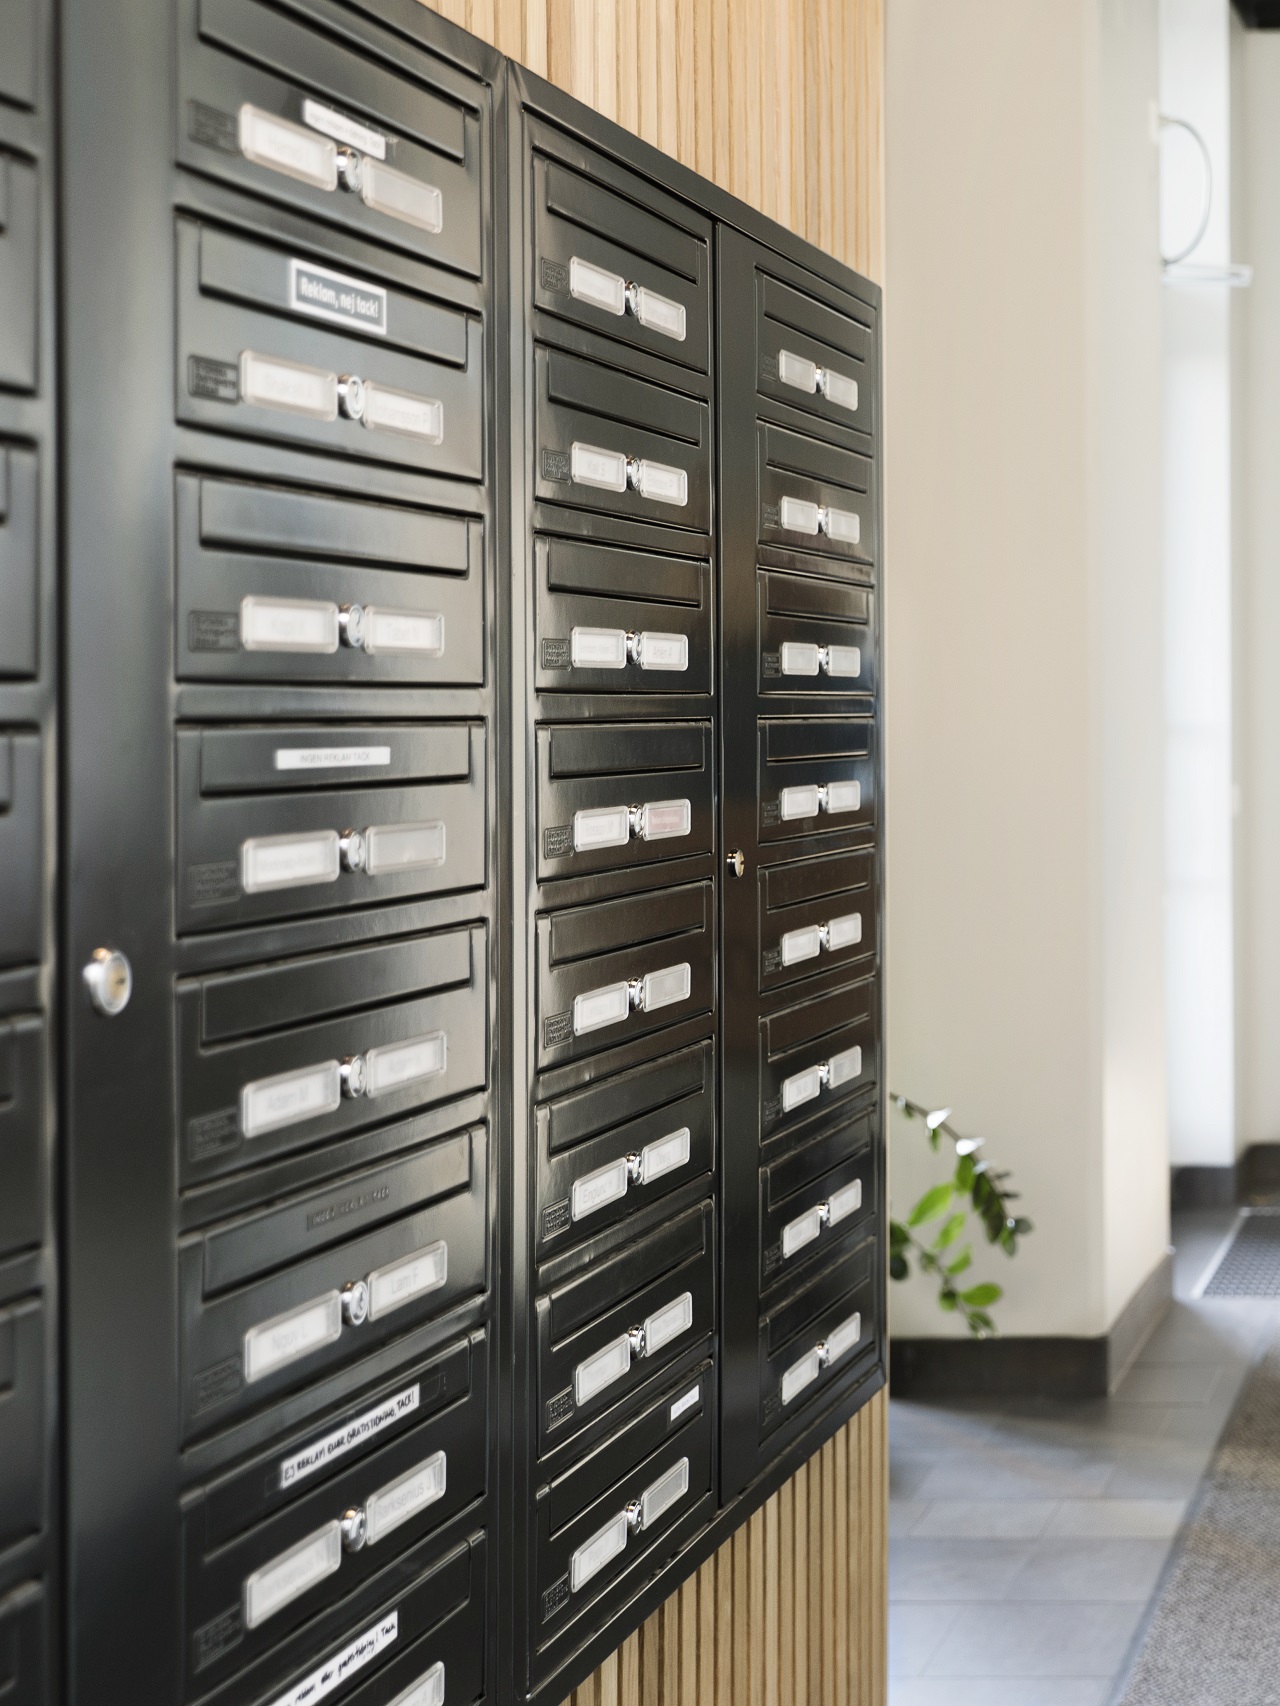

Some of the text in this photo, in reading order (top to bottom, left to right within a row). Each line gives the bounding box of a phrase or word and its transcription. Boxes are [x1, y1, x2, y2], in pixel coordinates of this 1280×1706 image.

[301, 276, 379, 318] Reklam, nej tack!
[299, 751, 371, 764] INGEN REKLAM TACK
[390, 1275, 411, 1294] Lam
[283, 1463, 296, 1481] EJ
[296, 1447, 326, 1471] REKLAM
[397, 1390, 415, 1410] TACK!
